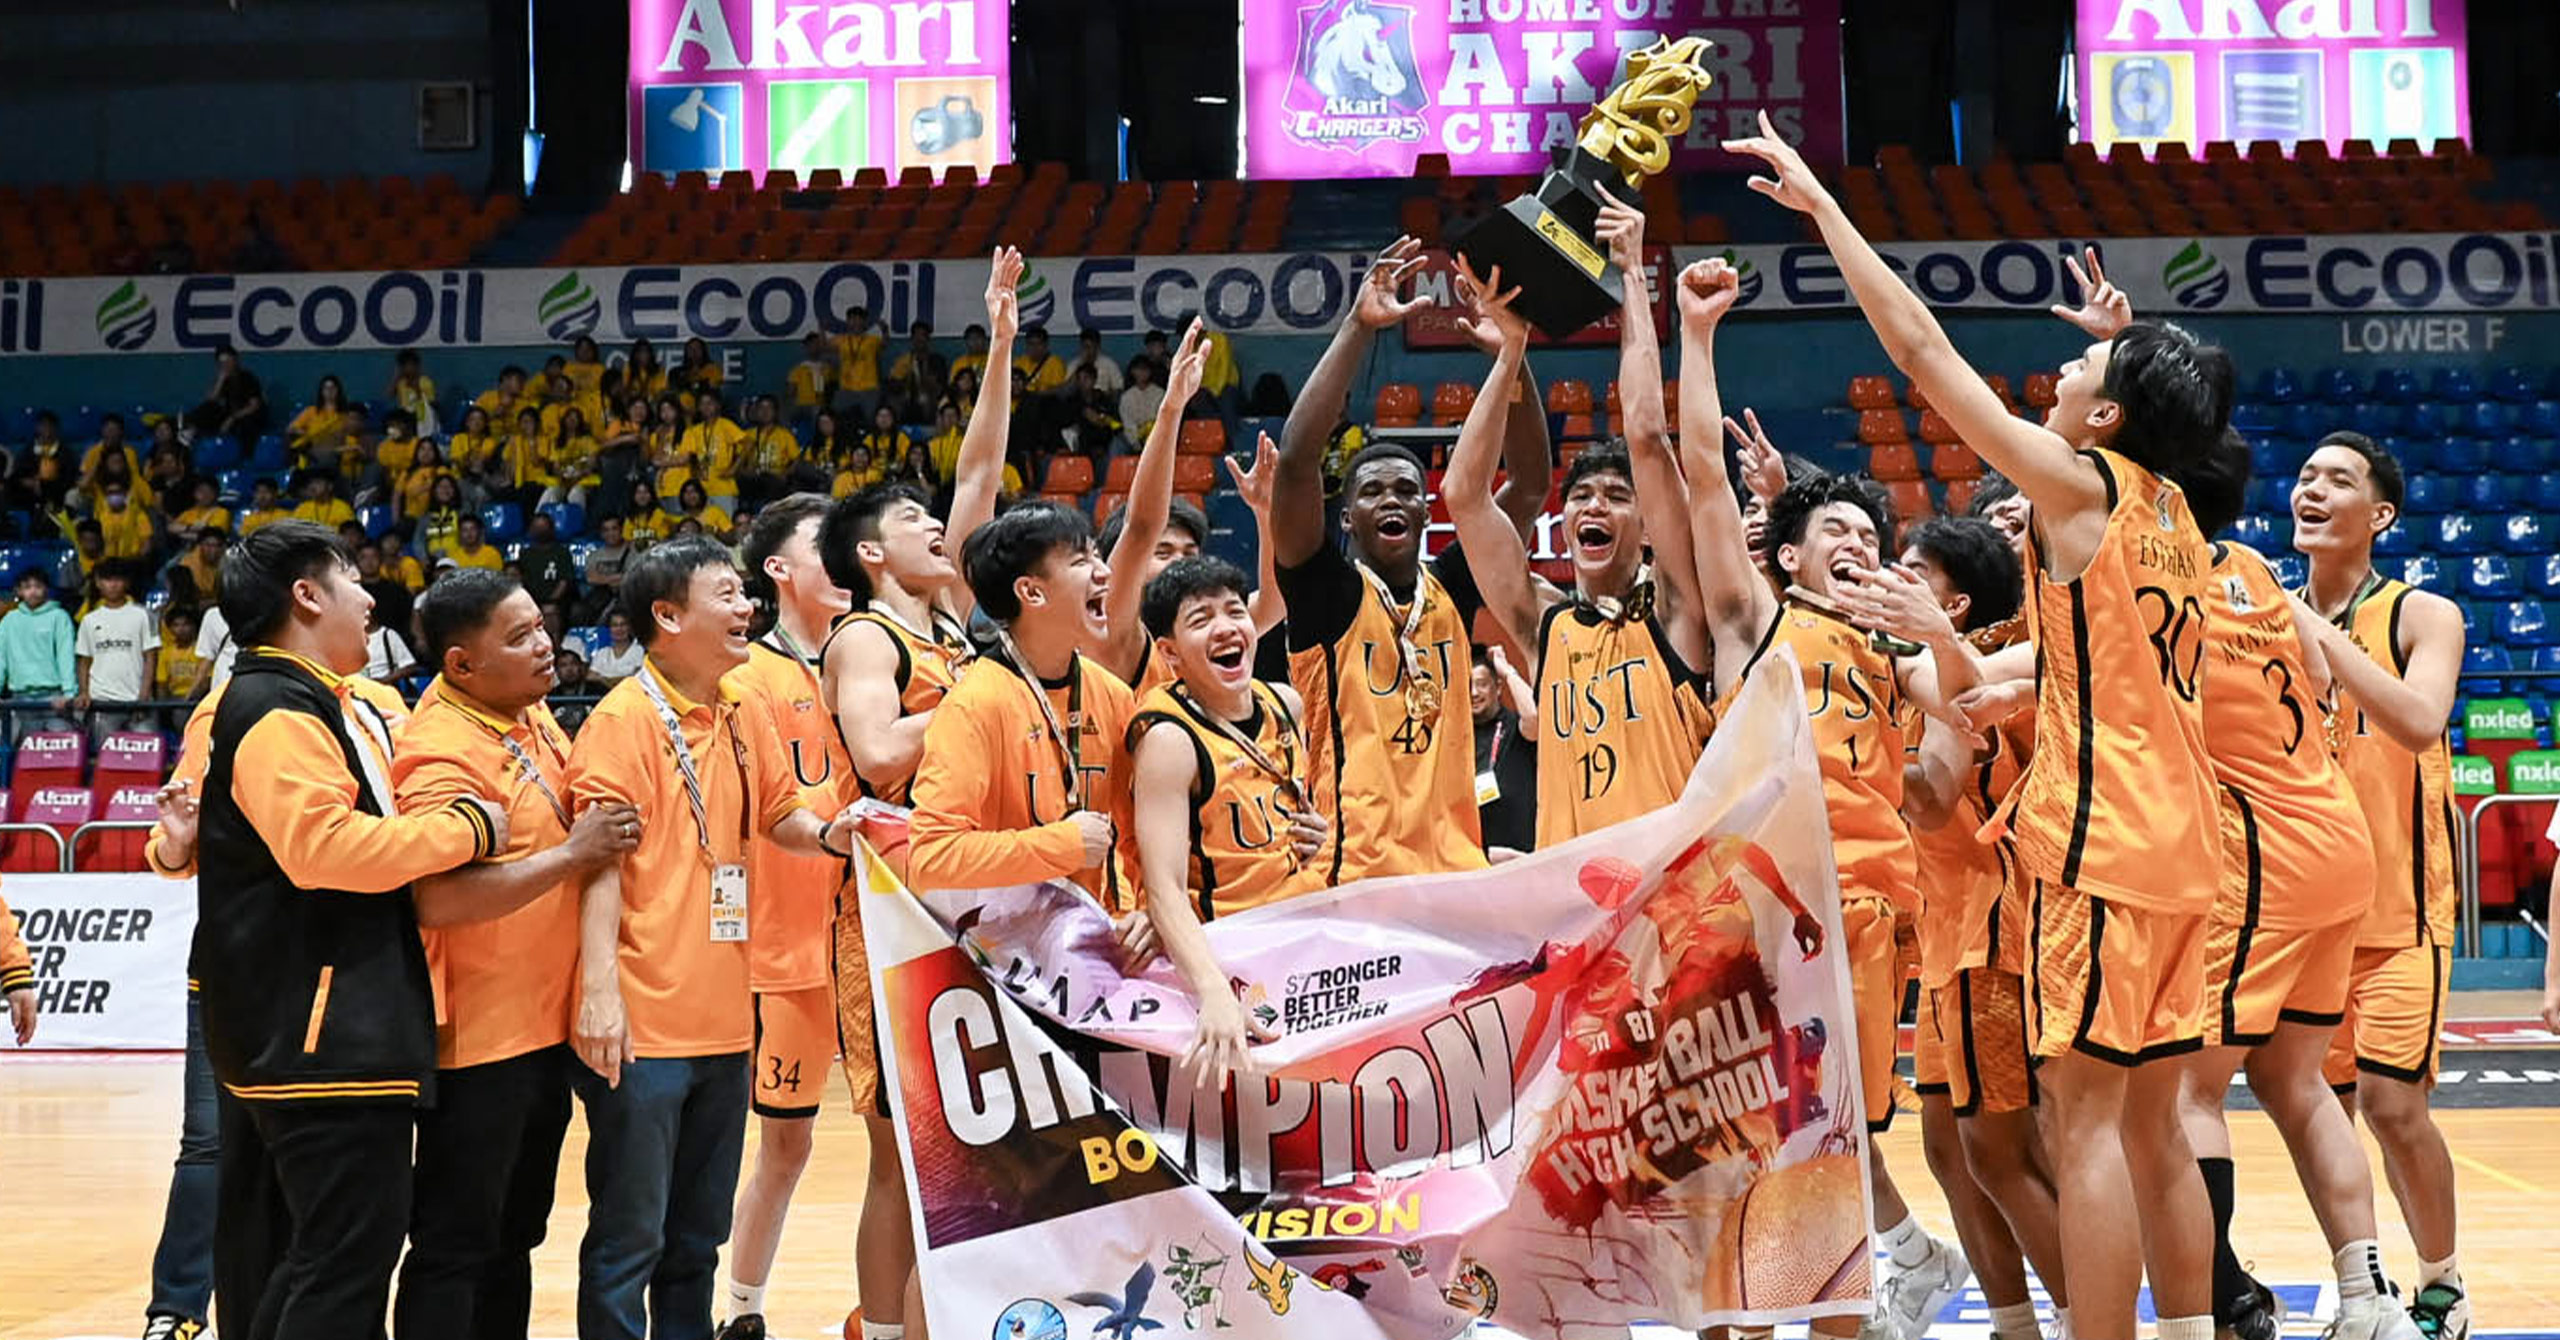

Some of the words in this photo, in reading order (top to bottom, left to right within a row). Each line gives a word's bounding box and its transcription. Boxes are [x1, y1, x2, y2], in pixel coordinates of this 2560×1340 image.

[656, 0, 982, 72] Akari
[1295, 110, 1421, 139] CHARGERS
[1322, 96, 1388, 114] Akari
[172, 271, 485, 349] EcoOil
[617, 262, 936, 338] EcoOil
[2342, 319, 2471, 353] LOWER
[2485, 318, 2505, 352] F
[2135, 586, 2205, 702] 30
[1551, 657, 1648, 740] UST
[2262, 658, 2304, 756] 3
[2469, 708, 2535, 730] nxled
[20, 734, 80, 751] Akari
[101, 735, 160, 753] Akari
[1576, 742, 1617, 801] 19
[32, 789, 92, 806] Akari
[1285, 954, 1402, 996] STRONGER
[1284, 985, 1360, 1018] BETTER
[762, 1055, 802, 1093] 34
[1640, 1053, 1790, 1157] SCHOOL
